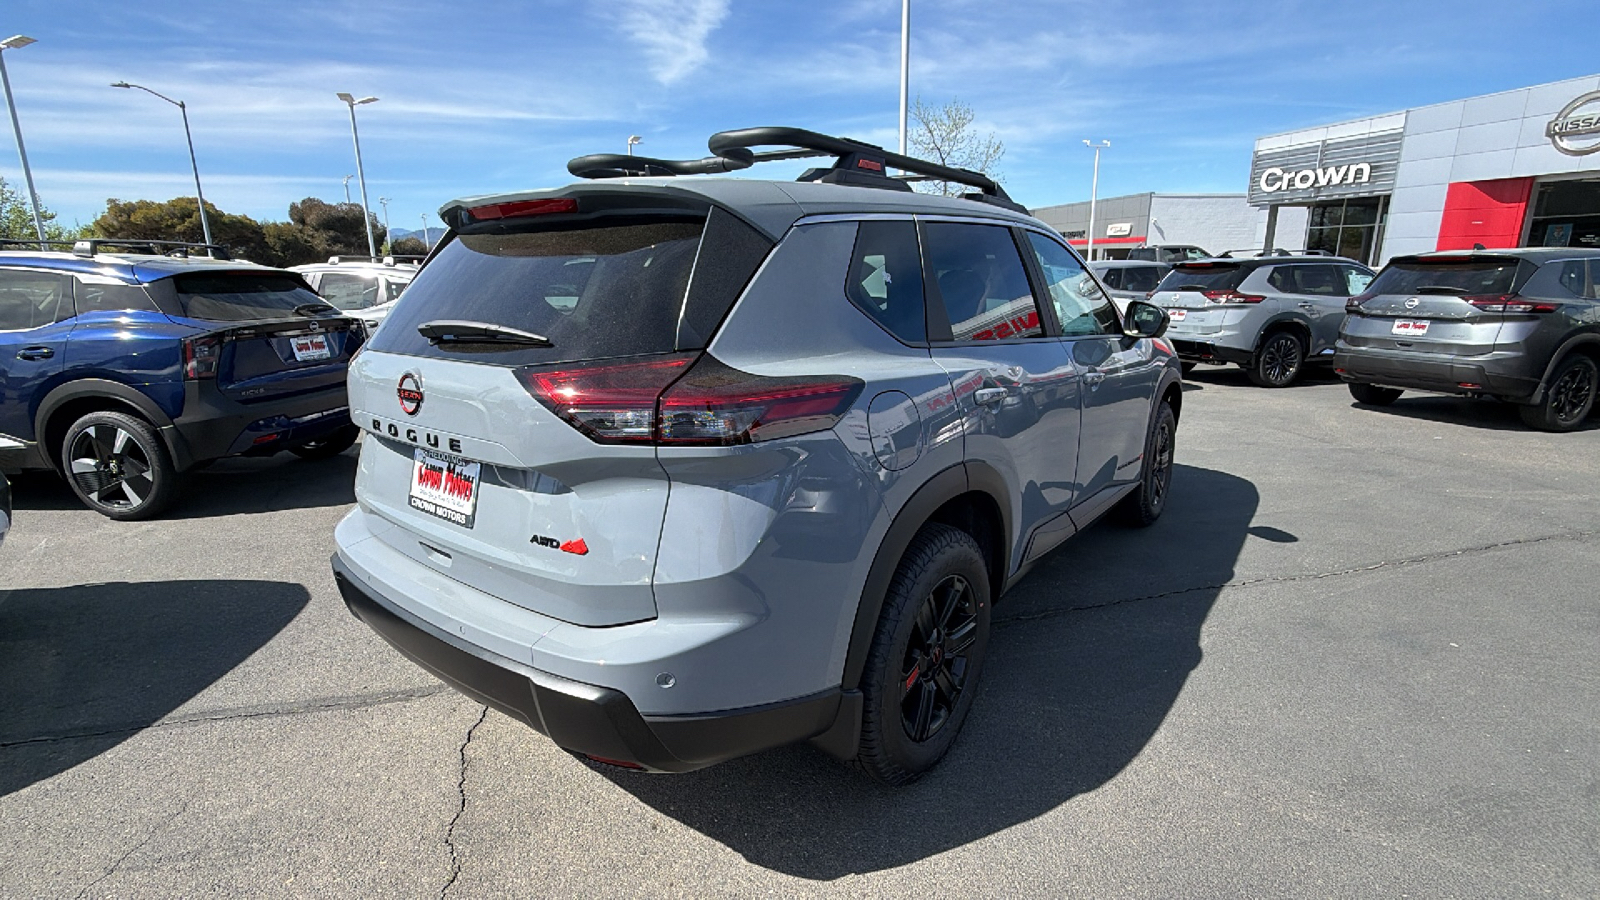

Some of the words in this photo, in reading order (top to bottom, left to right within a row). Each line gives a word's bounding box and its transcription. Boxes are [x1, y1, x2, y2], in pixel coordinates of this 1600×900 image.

[1260, 163, 1371, 192] Crown
[372, 419, 462, 453] ROGUE
[428, 450, 463, 467] REDDING
[411, 497, 435, 513] CROWN
[436, 506, 466, 524] MOTORS
[530, 534, 560, 549] AWD
